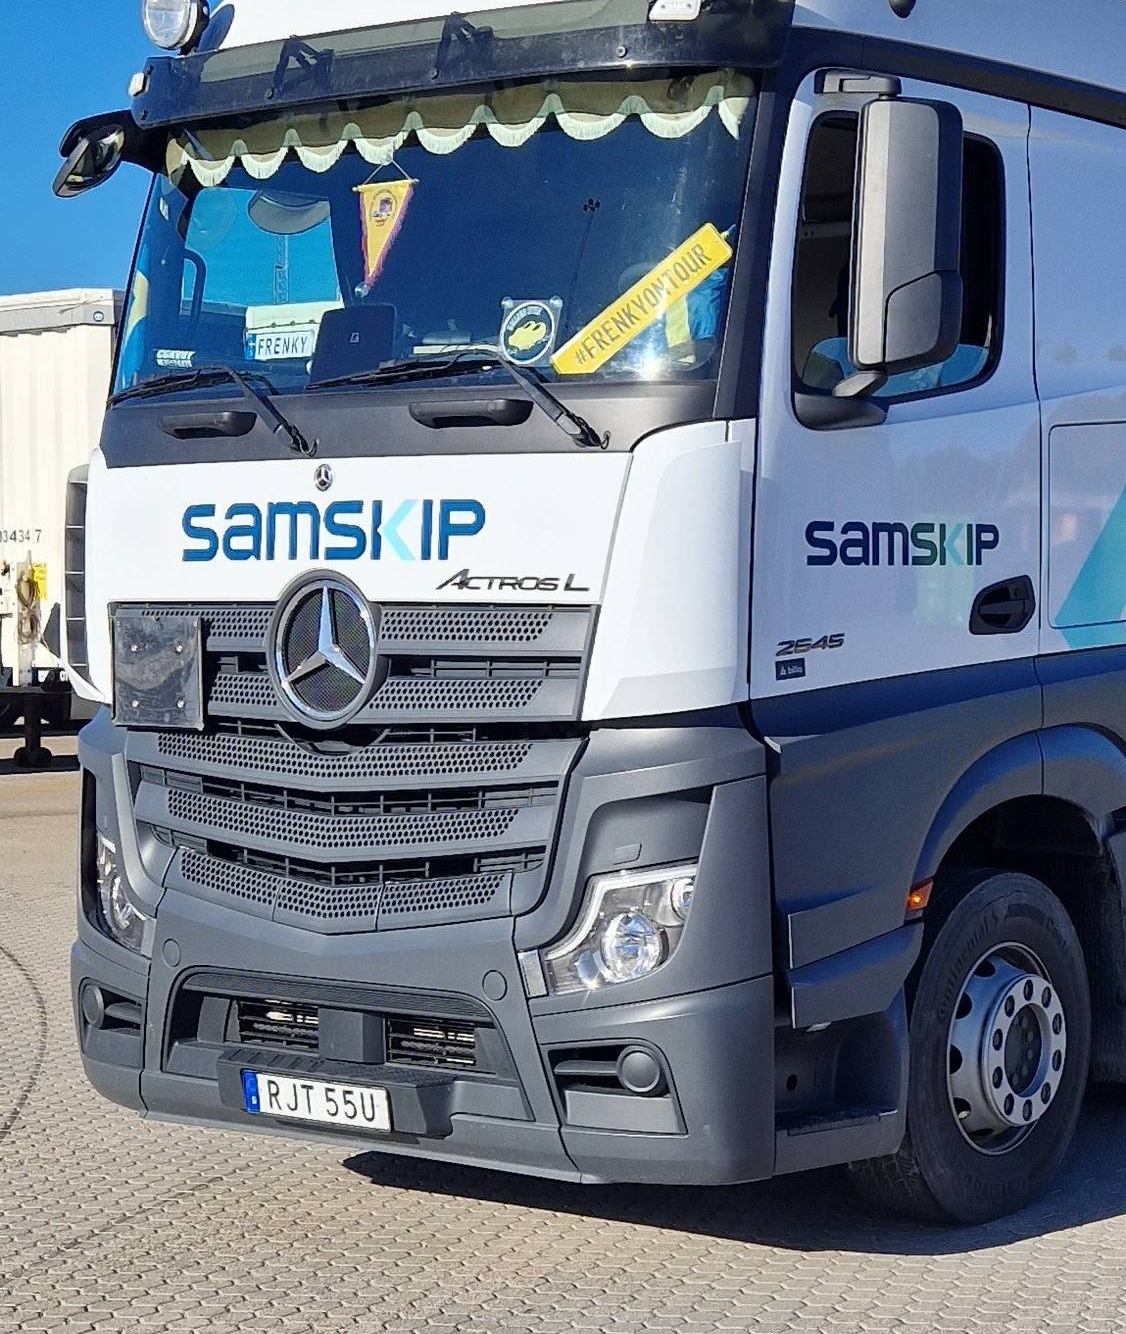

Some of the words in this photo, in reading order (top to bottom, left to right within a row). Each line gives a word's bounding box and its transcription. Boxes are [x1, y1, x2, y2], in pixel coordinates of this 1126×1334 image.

[575, 243, 712, 365] #FRENKYONTOUR
[257, 335, 308, 356] FRENKY
[776, 633, 845, 657] 2645
[267, 1080, 313, 1114] RJT
[325, 1087, 375, 1122] 55U
